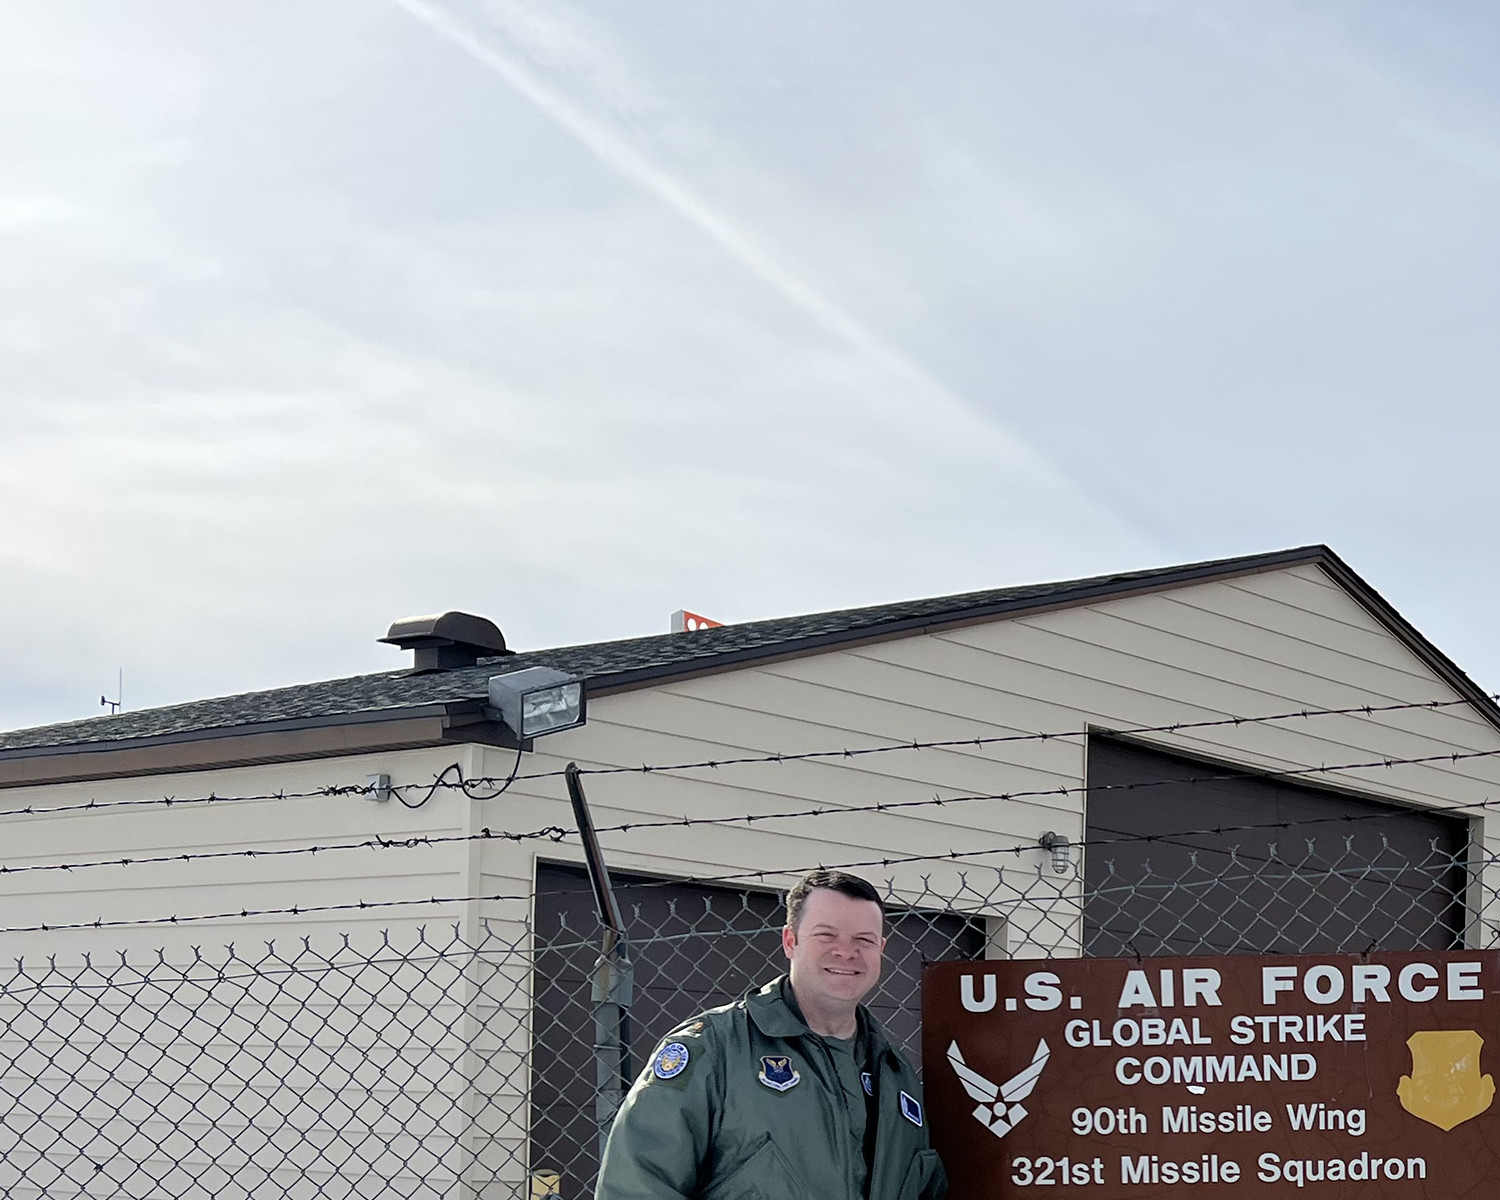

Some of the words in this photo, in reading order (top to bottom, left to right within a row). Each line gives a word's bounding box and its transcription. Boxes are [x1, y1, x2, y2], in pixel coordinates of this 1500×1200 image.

[960, 972, 1082, 1012] U.S.
[1117, 968, 1223, 1008] AIR
[1262, 962, 1485, 1005] FORCE
[1064, 1017, 1212, 1048] GLOBAL
[1229, 1013, 1367, 1045] STRIKE
[1115, 1053, 1317, 1085] COMMAND
[1071, 1106, 1148, 1136] 90th
[1162, 1104, 1273, 1133] Missile
[1285, 1103, 1367, 1136] Wing
[1011, 1156, 1105, 1186] 321st
[1121, 1154, 1241, 1184] Missile
[1257, 1151, 1427, 1188] Squadron
